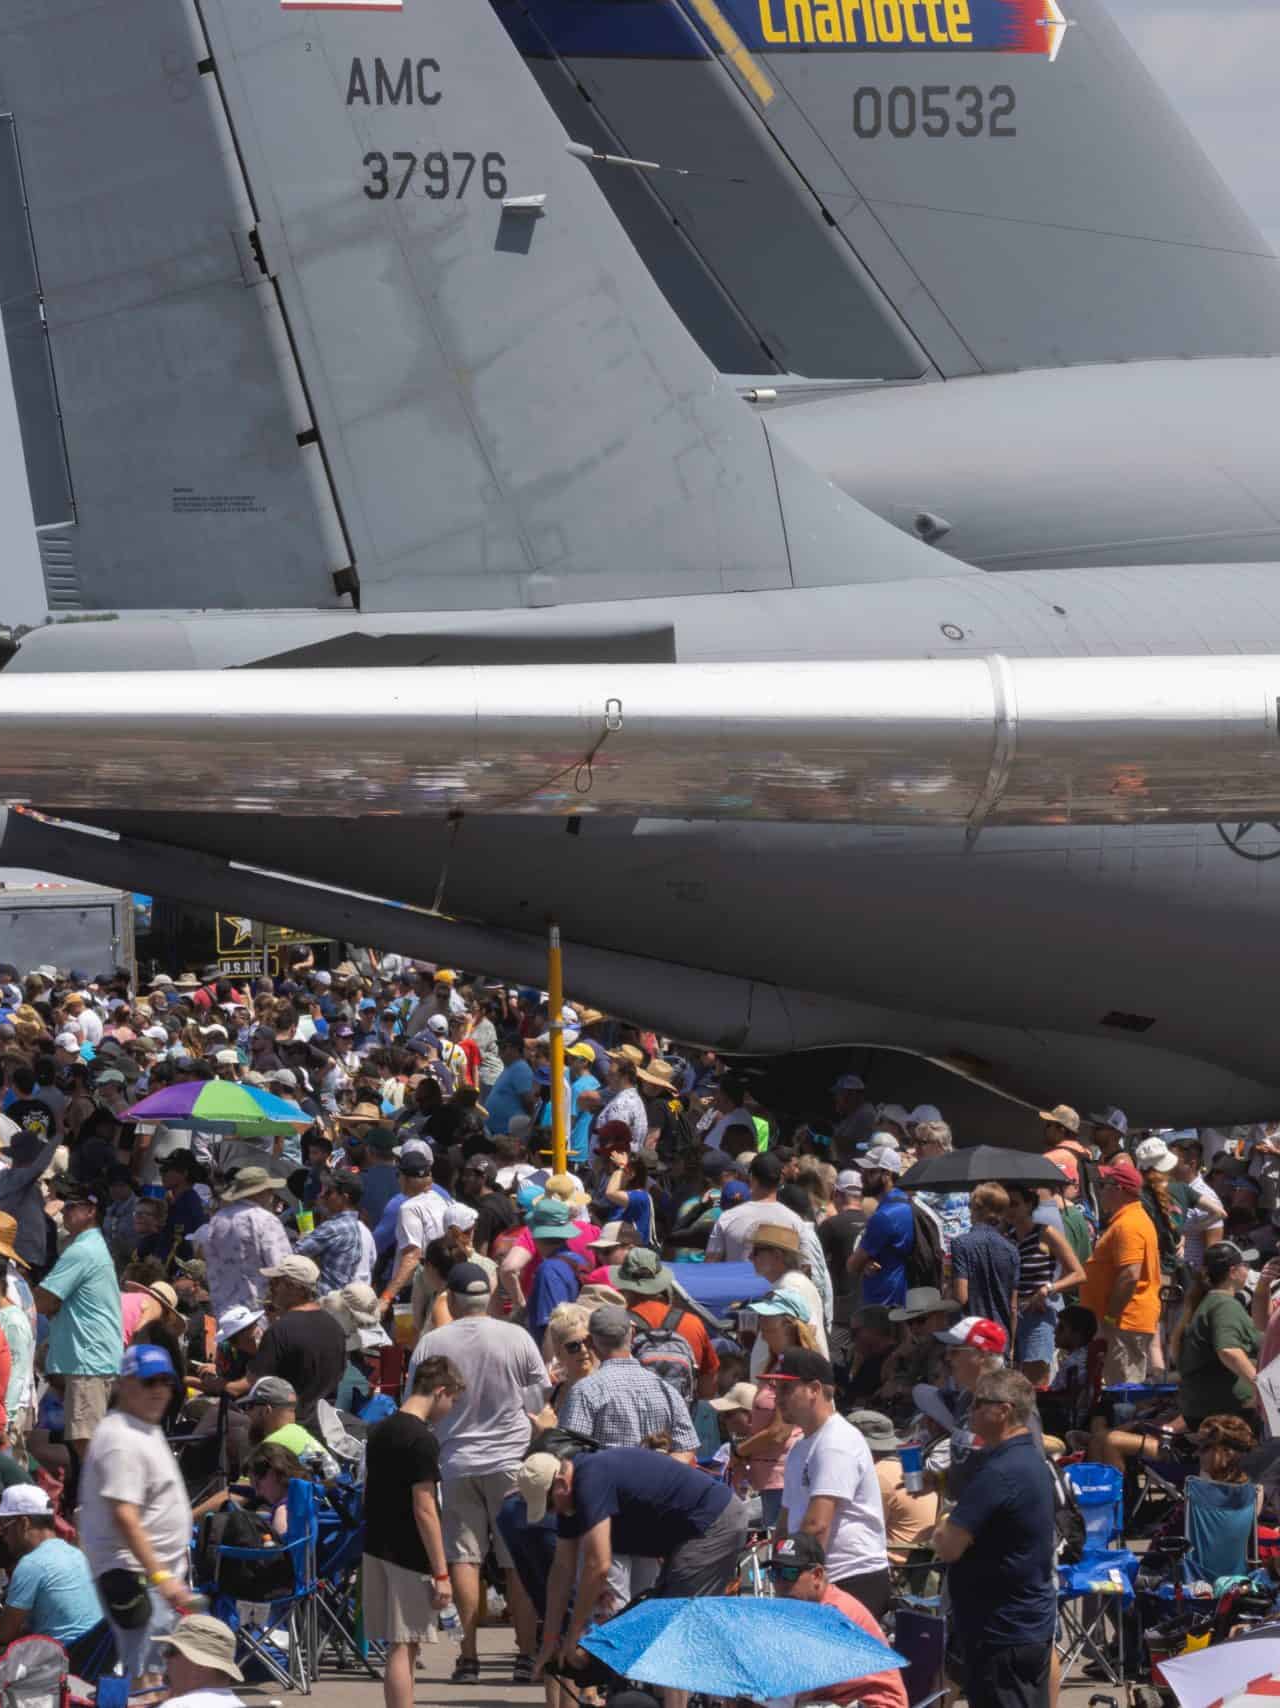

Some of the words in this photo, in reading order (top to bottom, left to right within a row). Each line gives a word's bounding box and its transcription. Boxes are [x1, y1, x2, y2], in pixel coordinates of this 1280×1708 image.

[758, 0, 973, 43] Charlotte
[346, 57, 442, 105] AMC
[853, 85, 1017, 138] 00532
[363, 152, 508, 200] 37976
